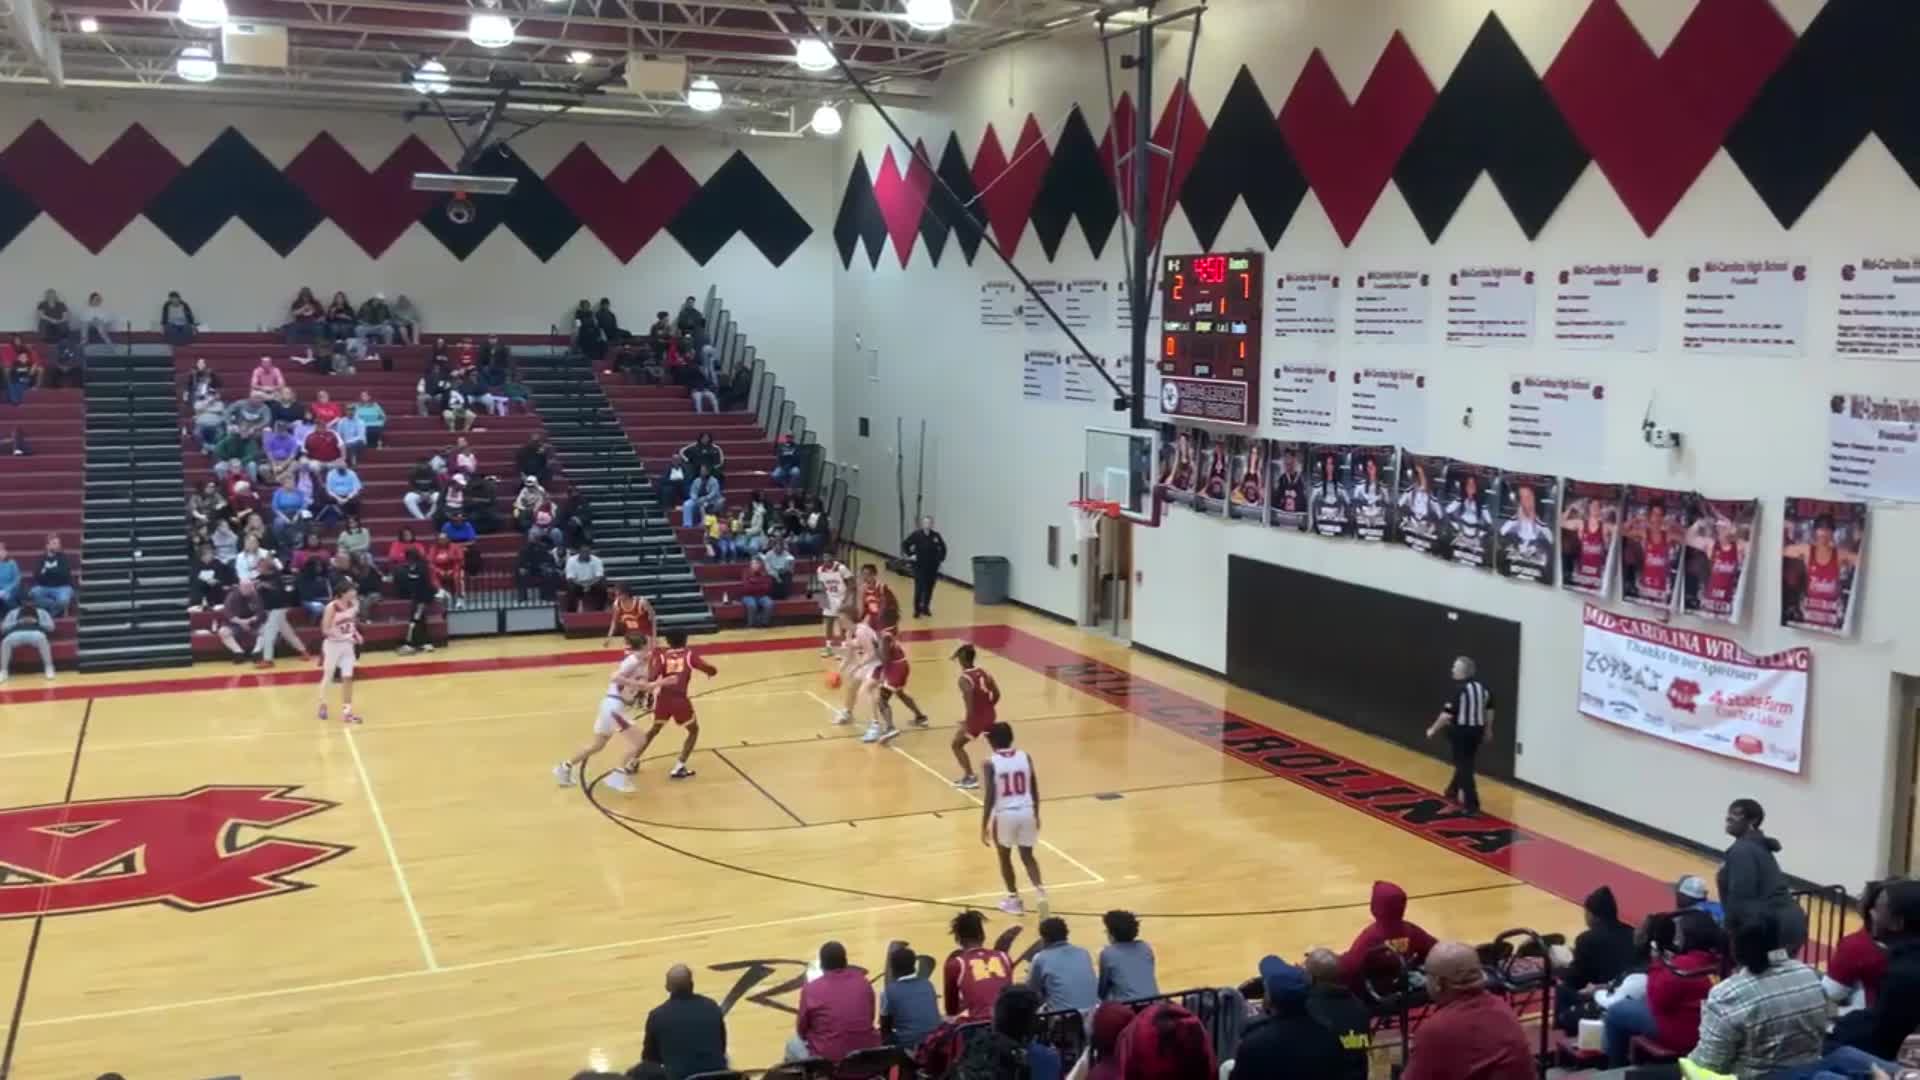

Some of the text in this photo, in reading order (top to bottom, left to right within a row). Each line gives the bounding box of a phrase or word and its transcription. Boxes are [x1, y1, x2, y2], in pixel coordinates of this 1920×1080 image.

[1173, 273, 1249, 300] 2 7
[1219, 297, 1225, 315] 1
[1000, 771, 1026, 797] 10
